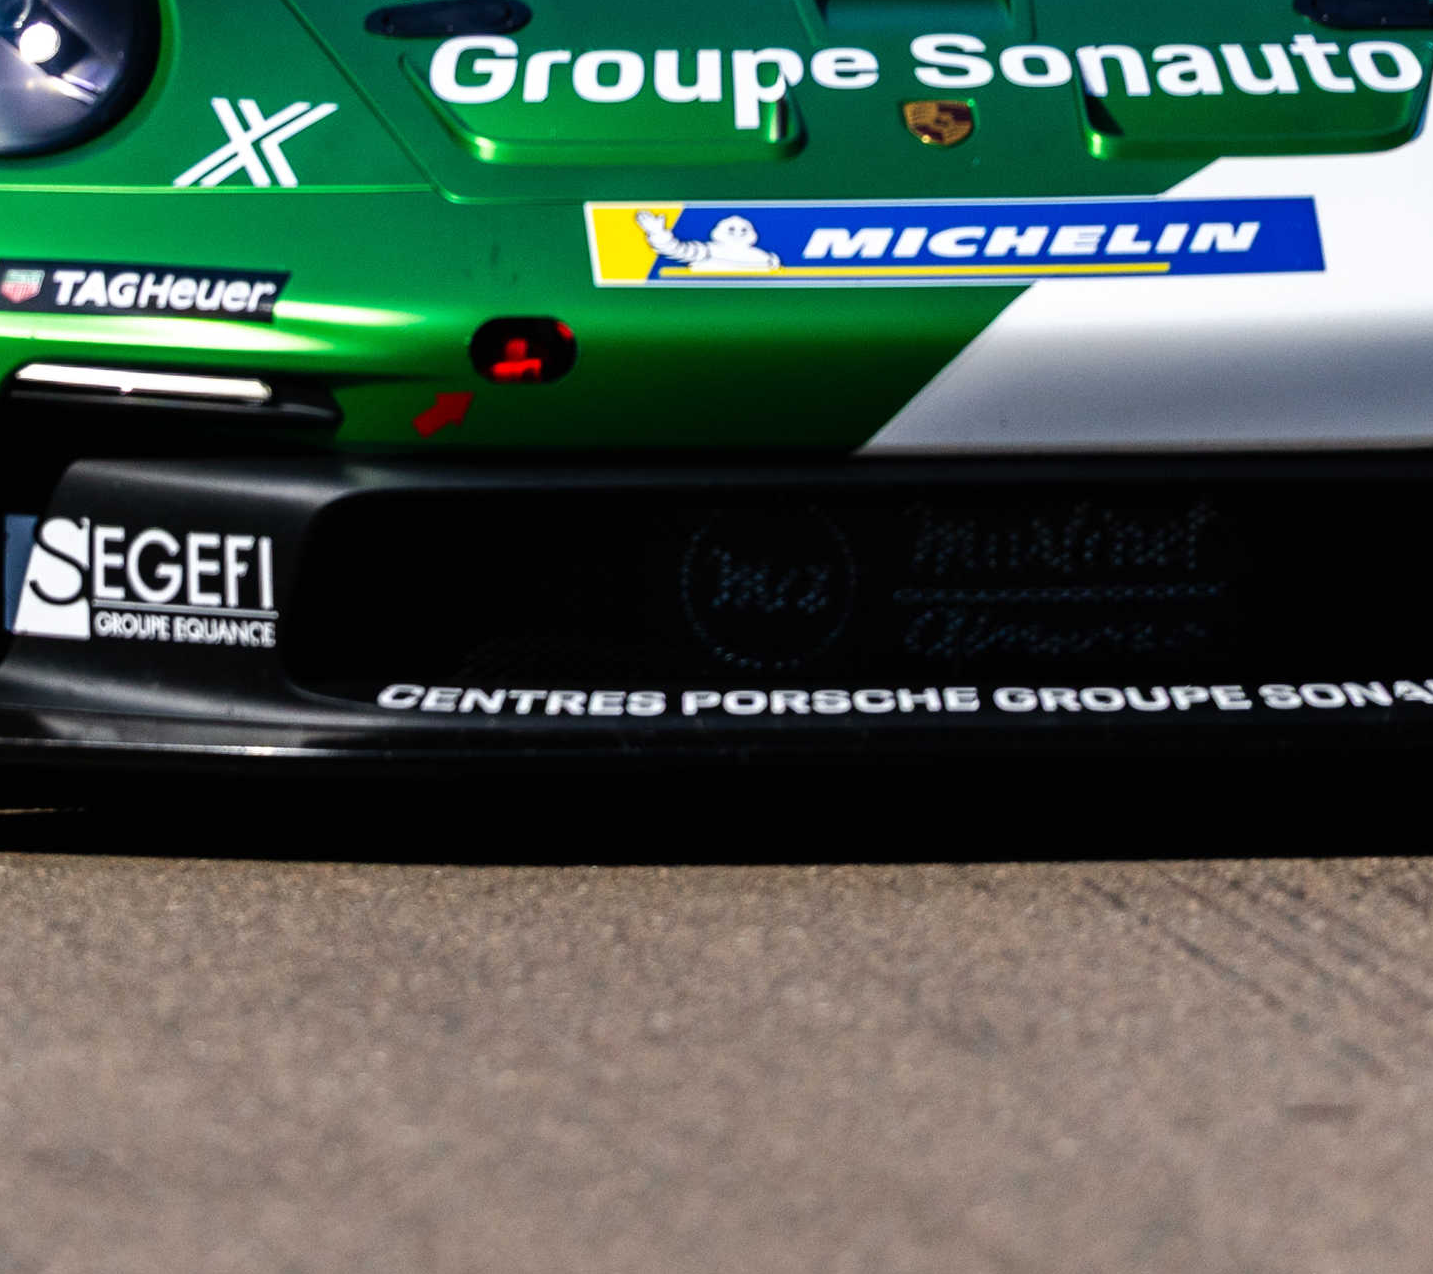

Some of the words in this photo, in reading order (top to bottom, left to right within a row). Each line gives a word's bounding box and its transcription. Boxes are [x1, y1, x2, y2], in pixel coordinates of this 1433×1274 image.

[430, 35, 879, 130] Groupe
[910, 33, 1423, 97] Sonauto
[802, 222, 1261, 260] MICHELIN
[30, 516, 274, 610] SEGEFI
[94, 611, 170, 640] GROUPE
[173, 618, 276, 648] EQUANCE
[376, 683, 666, 716] CENTRES
[681, 687, 980, 716] PORSCHE
[992, 685, 1252, 712] GROUPE
